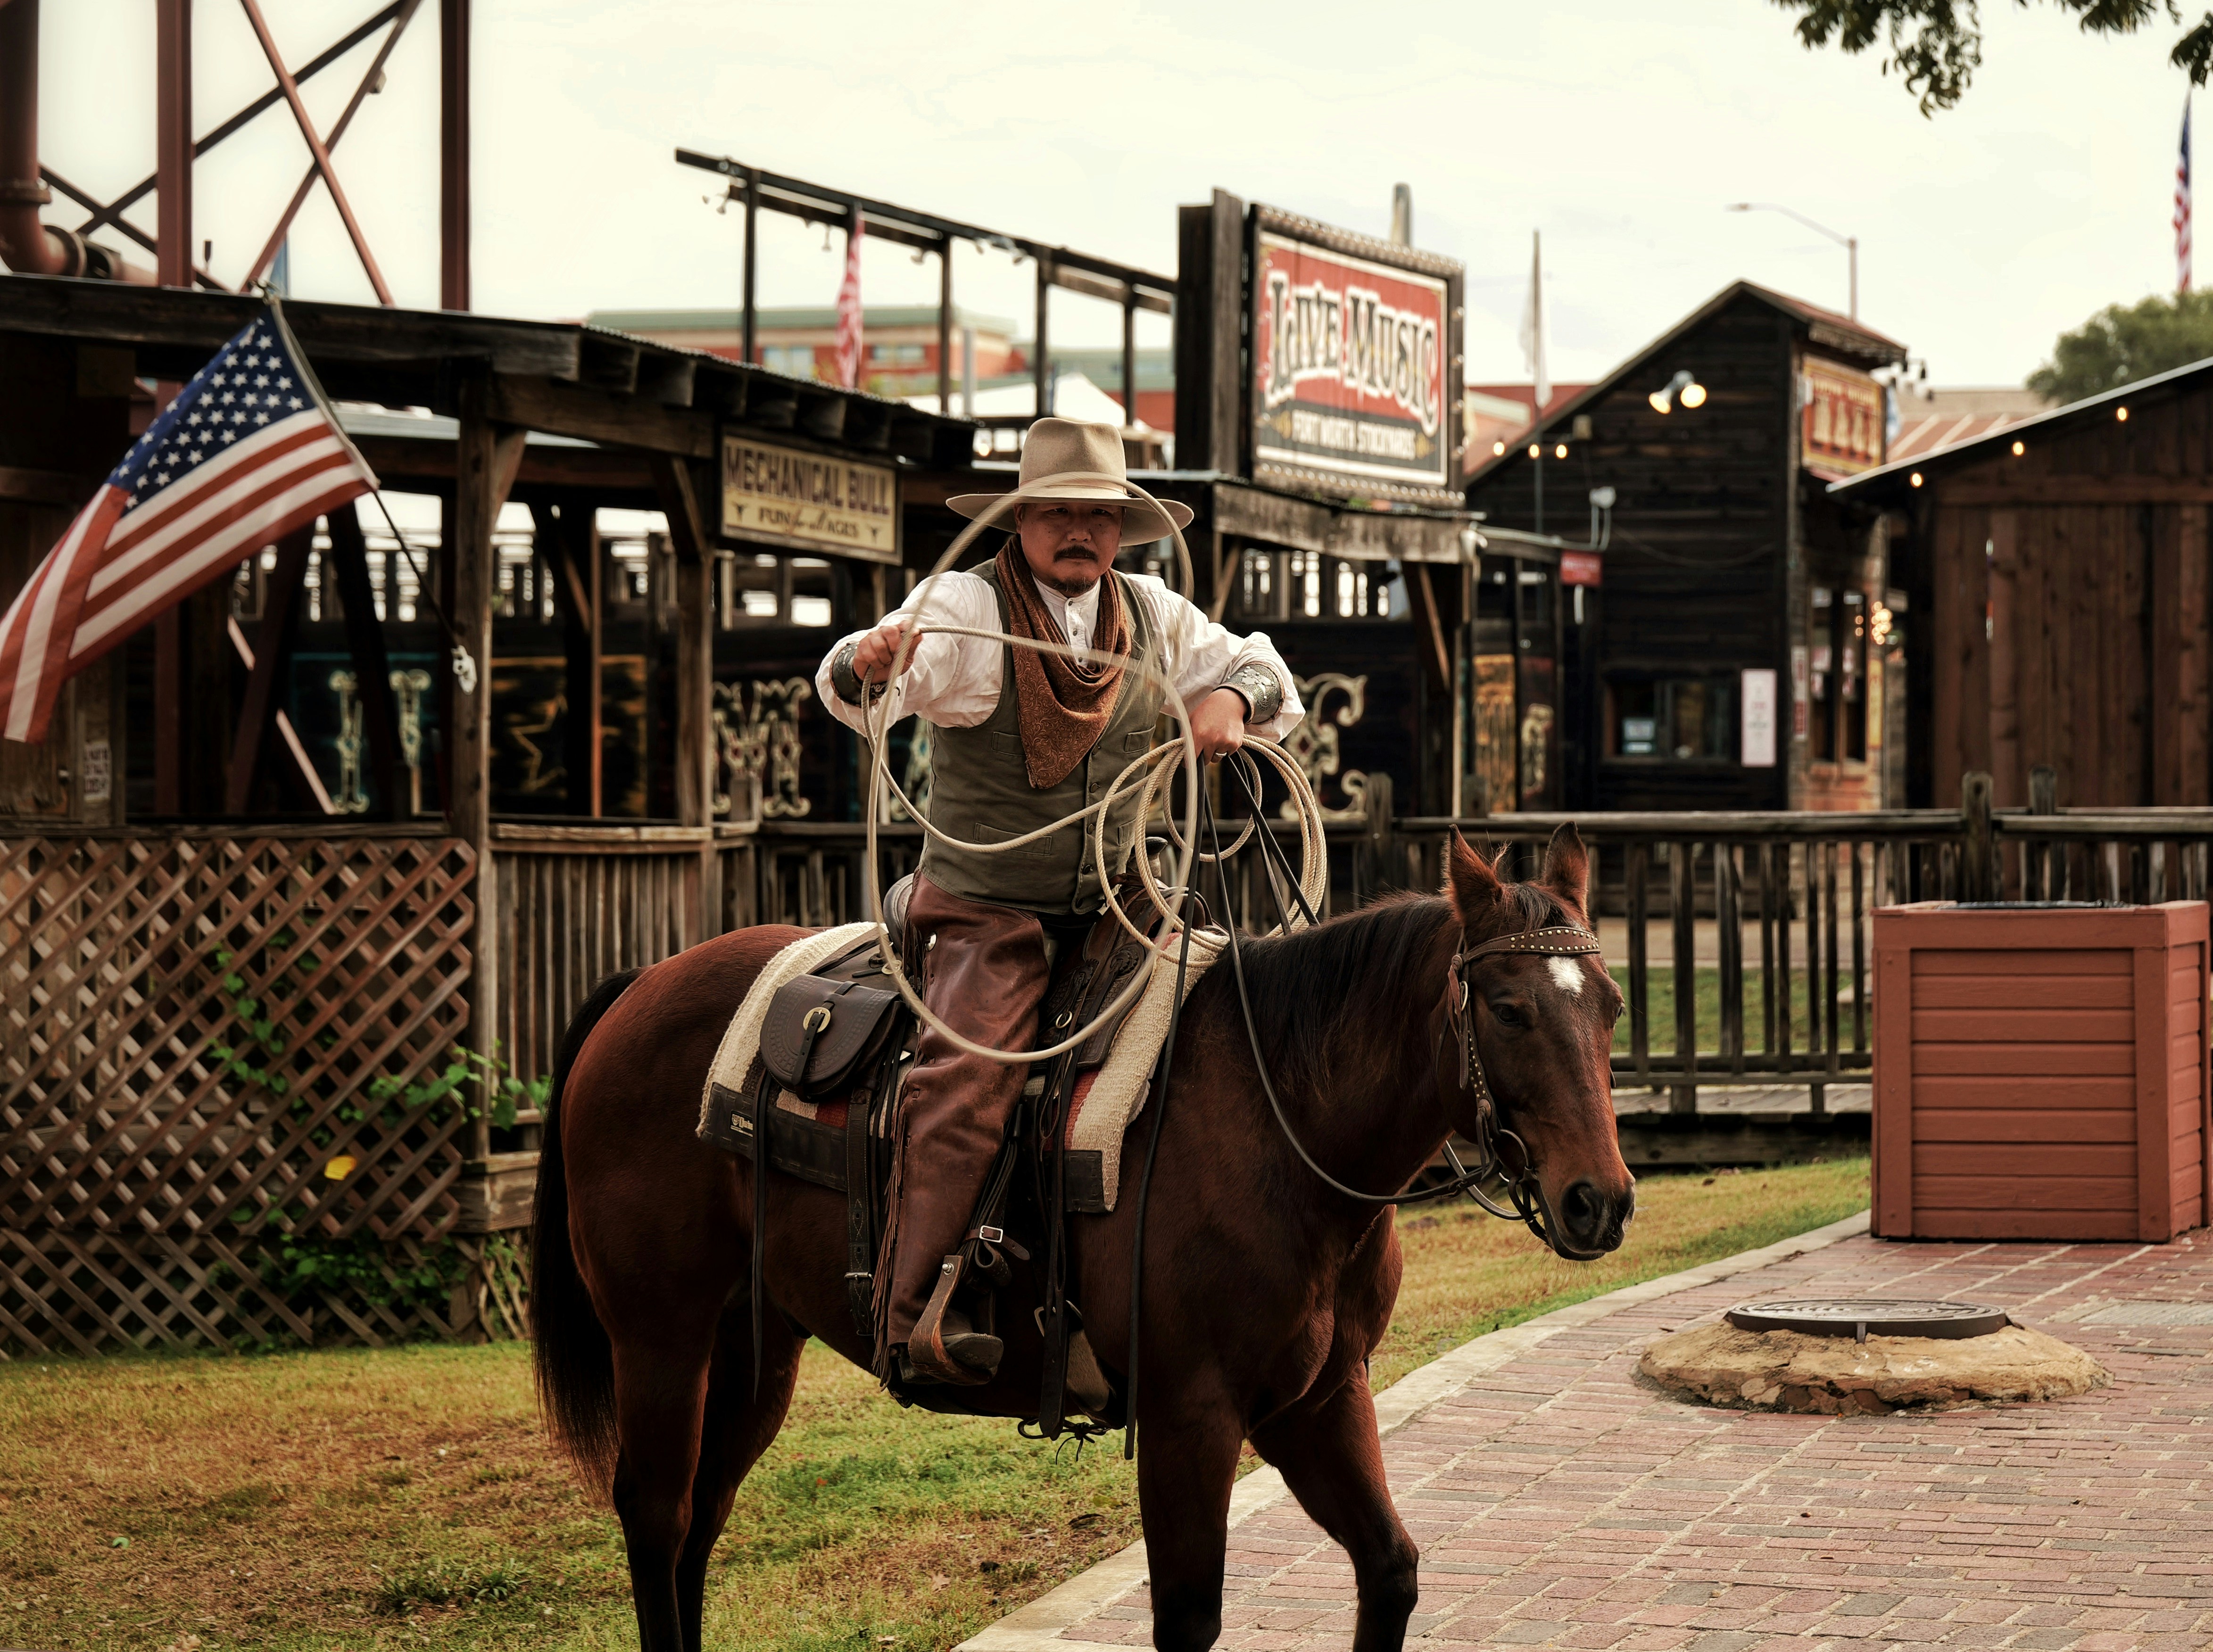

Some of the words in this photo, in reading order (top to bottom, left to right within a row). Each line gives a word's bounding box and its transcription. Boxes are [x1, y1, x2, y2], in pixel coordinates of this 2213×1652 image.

[1266, 270, 1342, 408] LIVE
[1344, 285, 1438, 436] MUSIC
[725, 445, 843, 508] MECHANICAL
[849, 471, 890, 515] BULL
[758, 506, 790, 524] FUN
[827, 519, 860, 538] AGES
